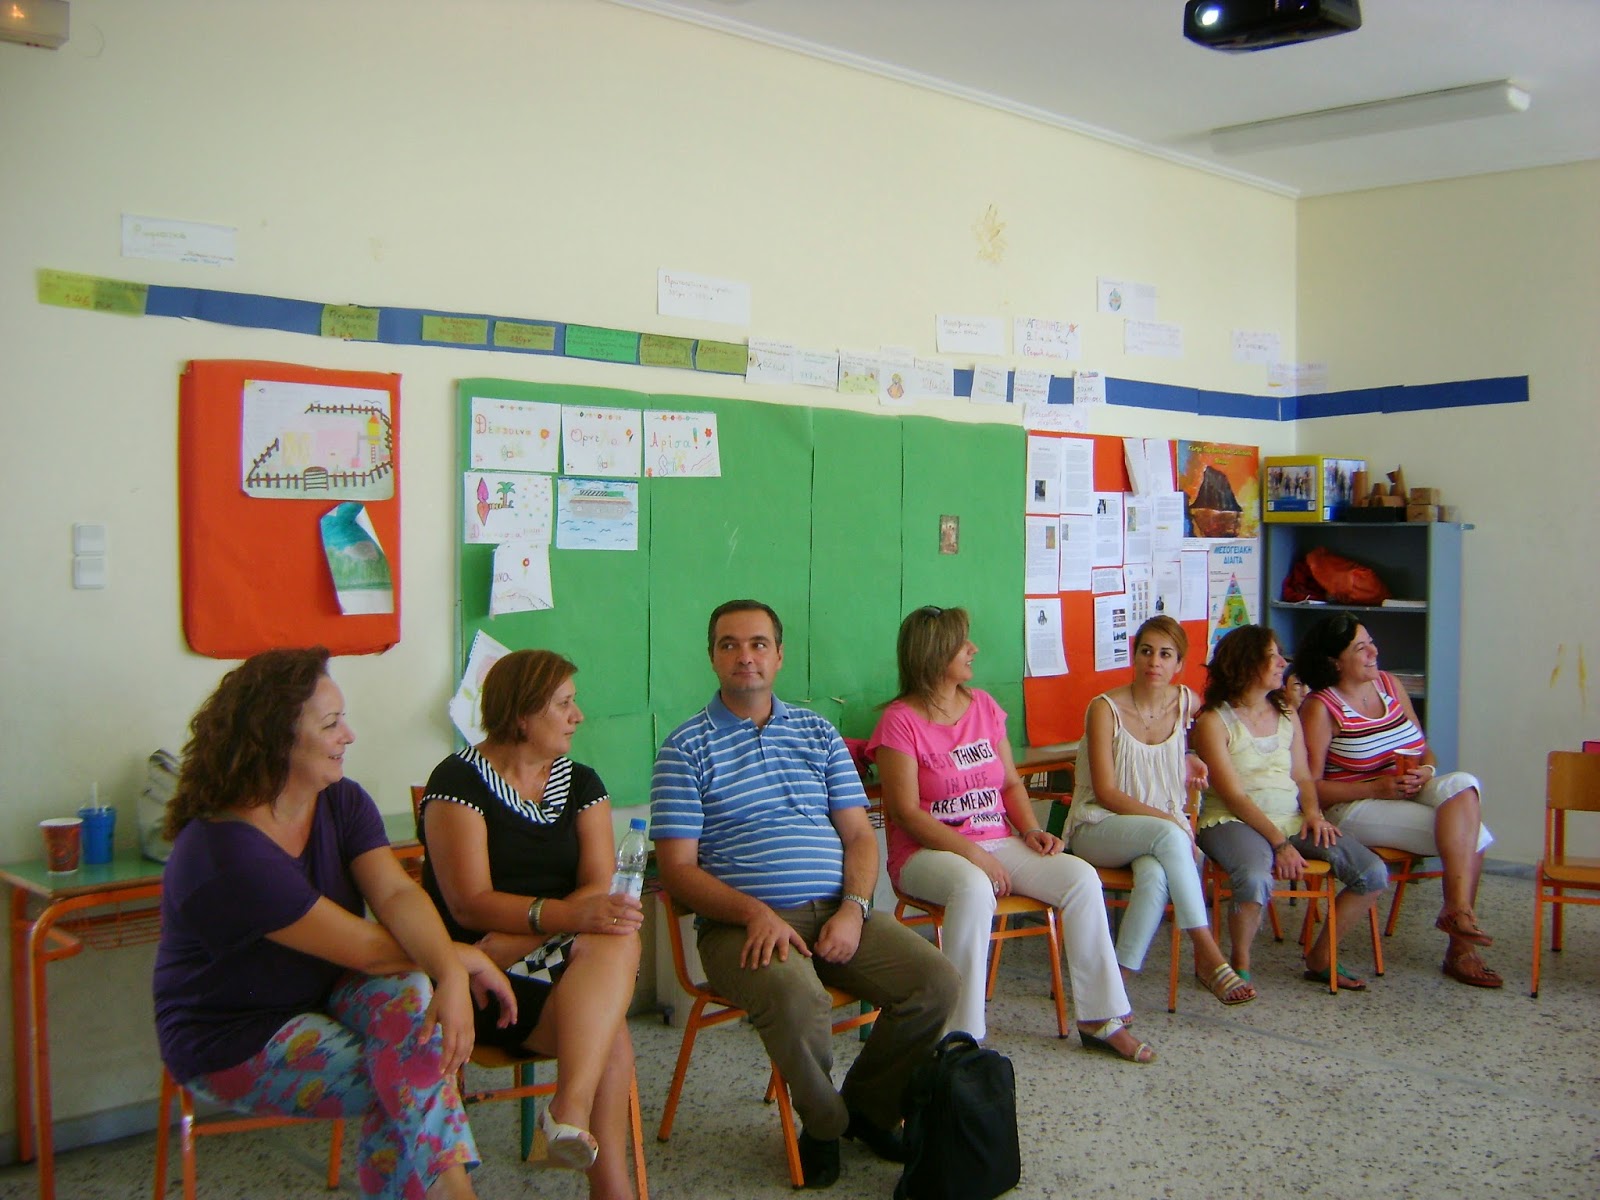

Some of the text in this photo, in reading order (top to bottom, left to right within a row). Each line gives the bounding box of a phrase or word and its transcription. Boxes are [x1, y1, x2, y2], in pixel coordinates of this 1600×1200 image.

[953, 743, 993, 766] THINGS
[945, 771, 989, 795] IN LIFE
[931, 790, 998, 814] ARE MEANT
